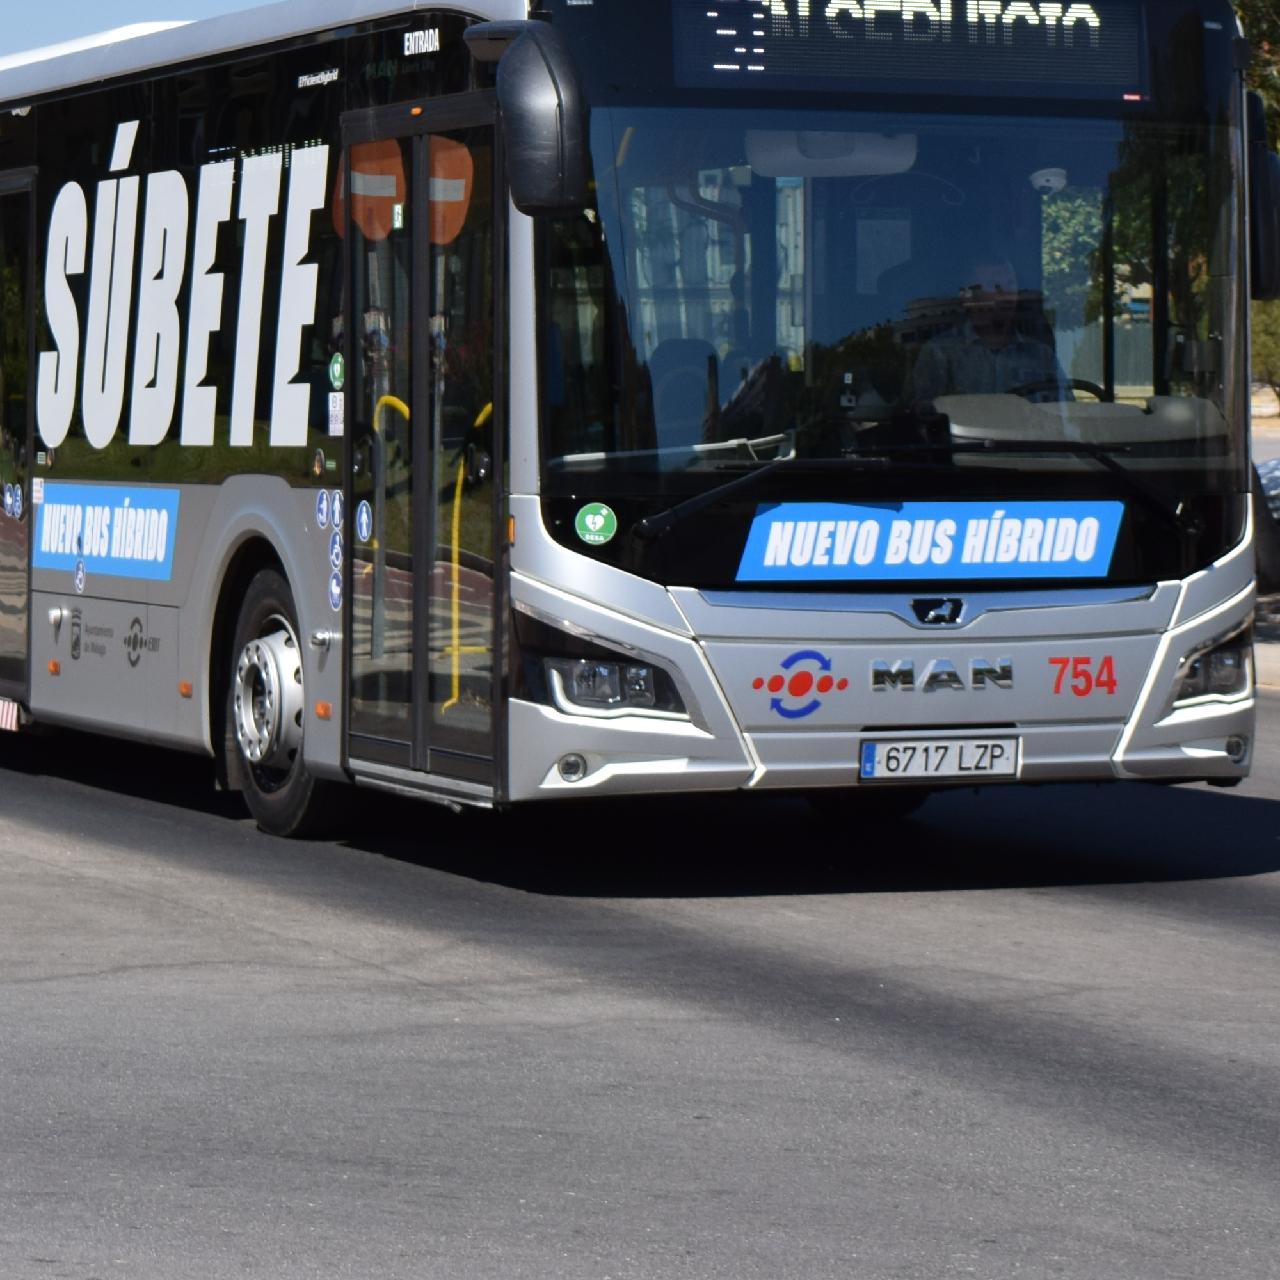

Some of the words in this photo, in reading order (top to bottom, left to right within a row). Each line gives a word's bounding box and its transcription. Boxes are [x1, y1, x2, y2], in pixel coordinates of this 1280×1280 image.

[404, 28, 440, 56] ENTRADA
[37, 120, 329, 450] SÚBETE
[41, 503, 82, 555] NUEVO
[83, 505, 110, 557] BUS
[111, 496, 168, 562] HÍBRIDO
[763, 519, 880, 567] NUEVO
[884, 519, 957, 565] BUS
[960, 509, 1100, 564] HÍBRIDO
[870, 657, 1014, 693] MAN
[1048, 655, 1118, 696] 754
[885, 745, 950, 772] 6717
[958, 744, 1005, 770] LZP
